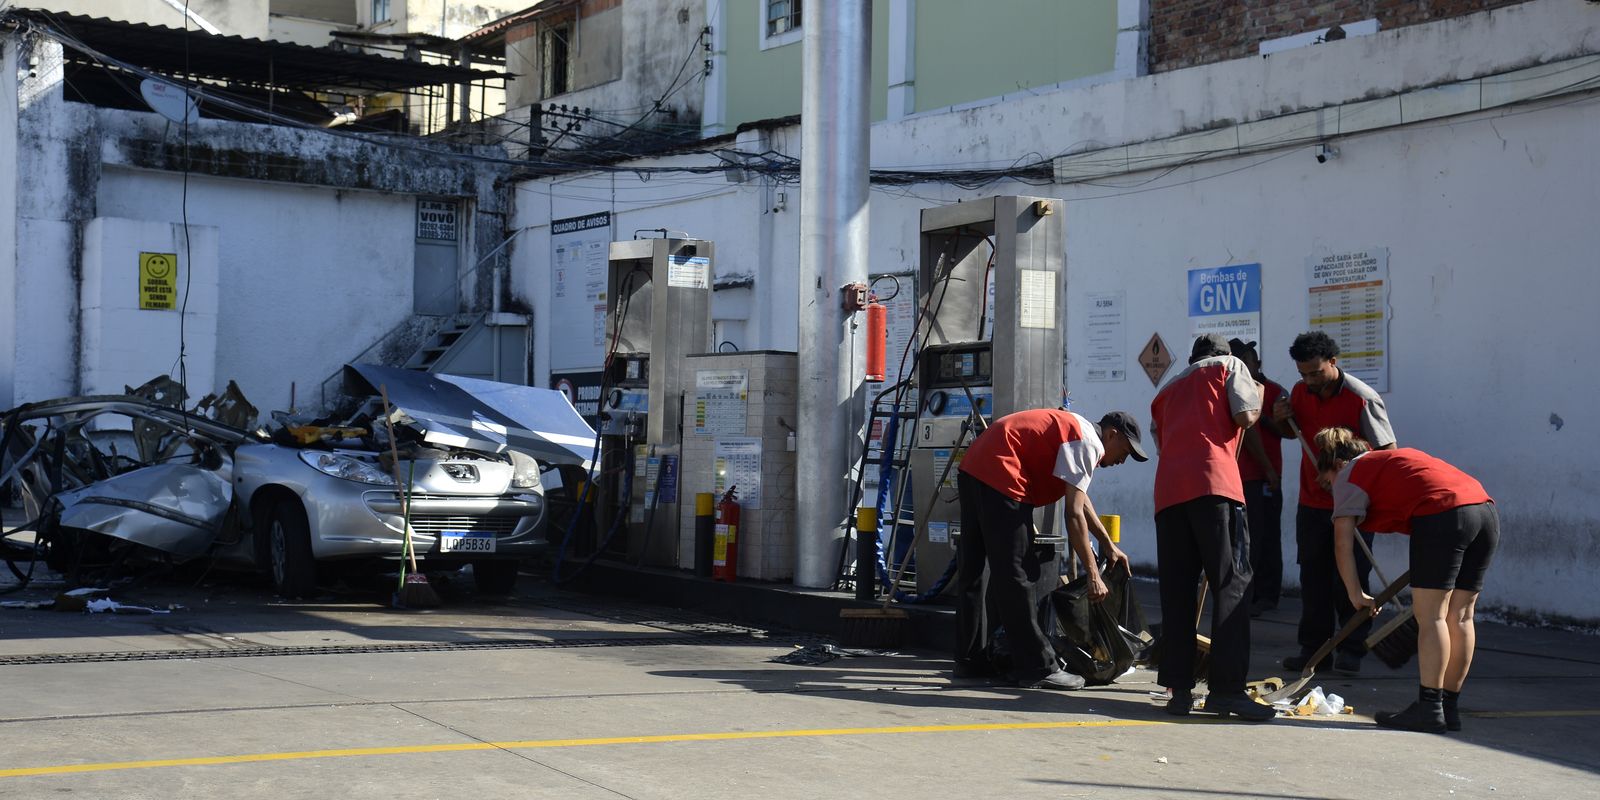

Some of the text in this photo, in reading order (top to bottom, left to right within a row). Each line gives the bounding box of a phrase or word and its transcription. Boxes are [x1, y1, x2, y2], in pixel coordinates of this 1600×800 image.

[553, 216, 608, 233] QUADRO DE AVISOS
[1314, 262, 1344, 271] CAPACIDADE
[1353, 258, 1377, 267] CILINDRO
[1337, 254, 1351, 262] SABIA
[1200, 270, 1247, 285] Bombas de
[1200, 281, 1248, 313] GNV
[924, 425, 931, 440] 3
[446, 539, 491, 551] LQP5B36
